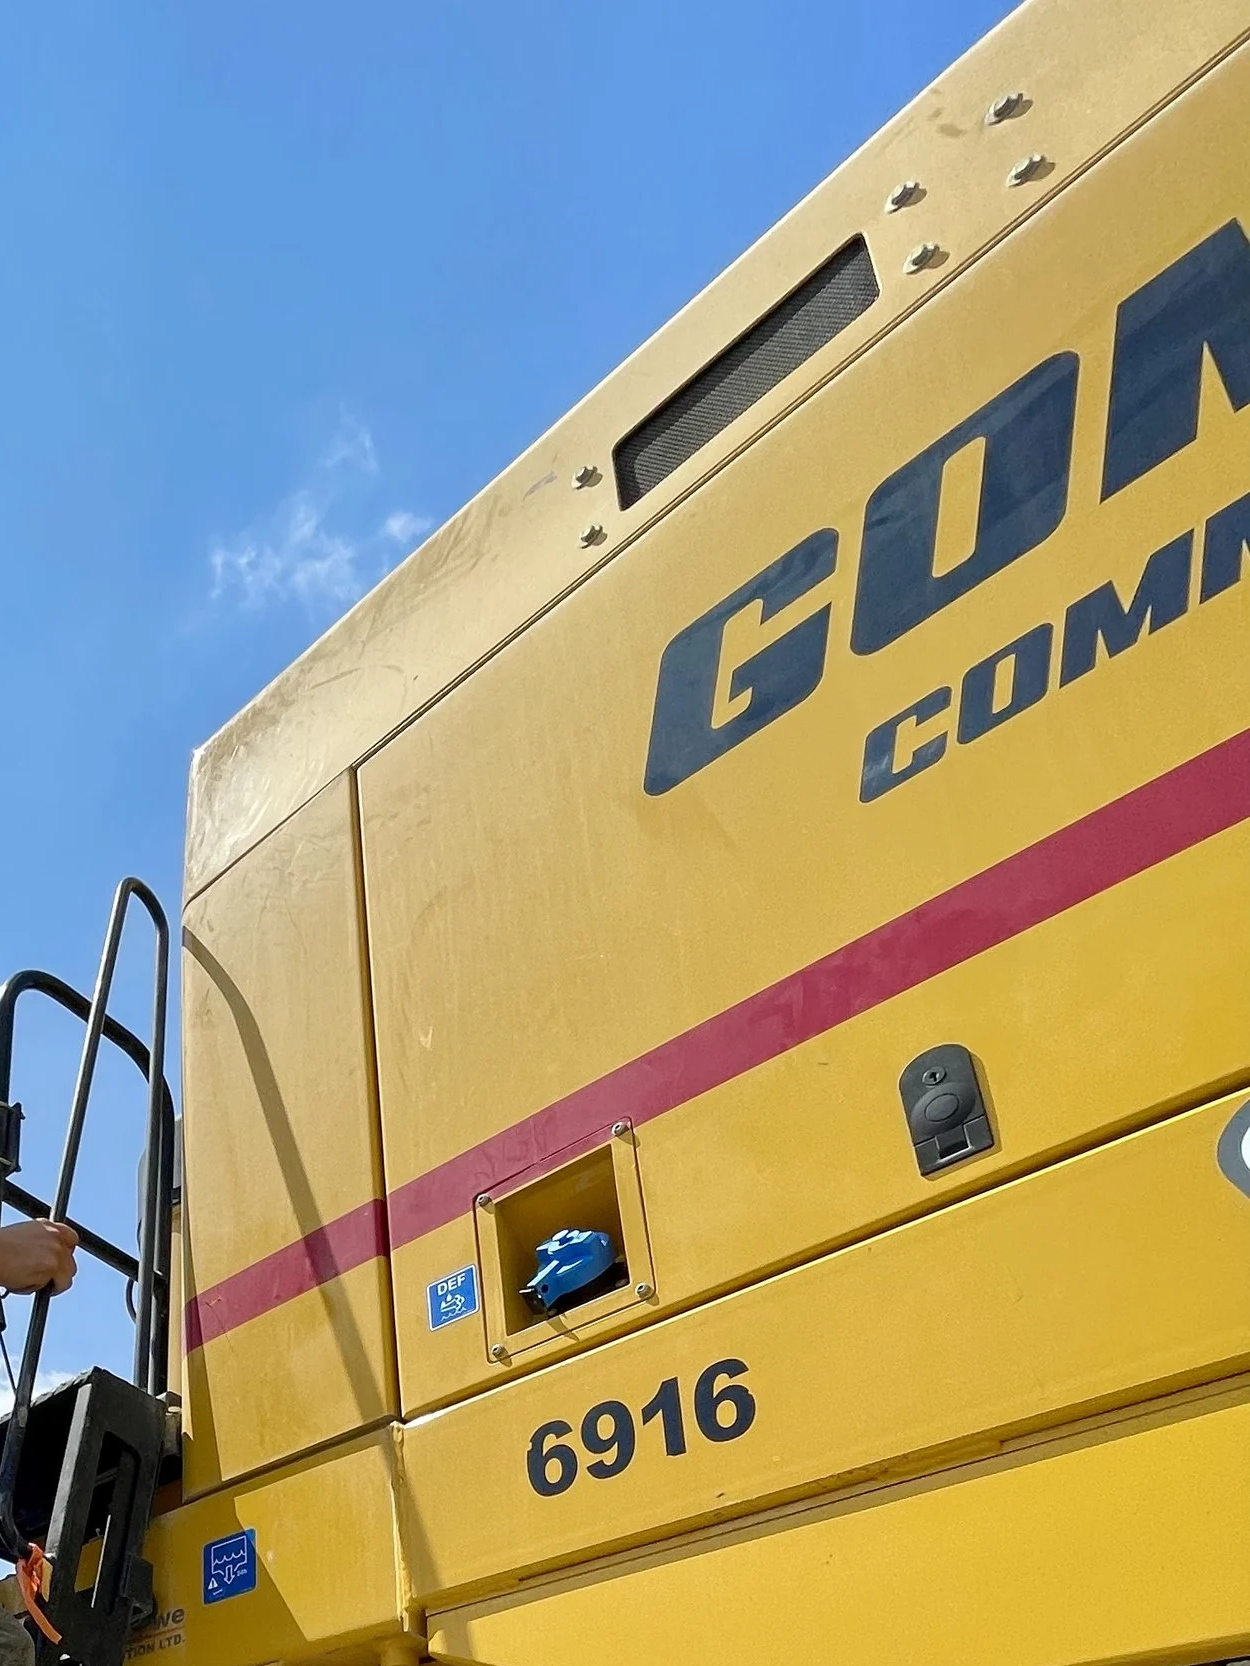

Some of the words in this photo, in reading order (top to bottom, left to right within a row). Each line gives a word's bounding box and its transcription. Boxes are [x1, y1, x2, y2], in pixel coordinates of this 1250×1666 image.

[437, 1273, 466, 1296] DEF
[527, 1358, 756, 1497] 6916
[159, 1633, 186, 1649] LTD.
